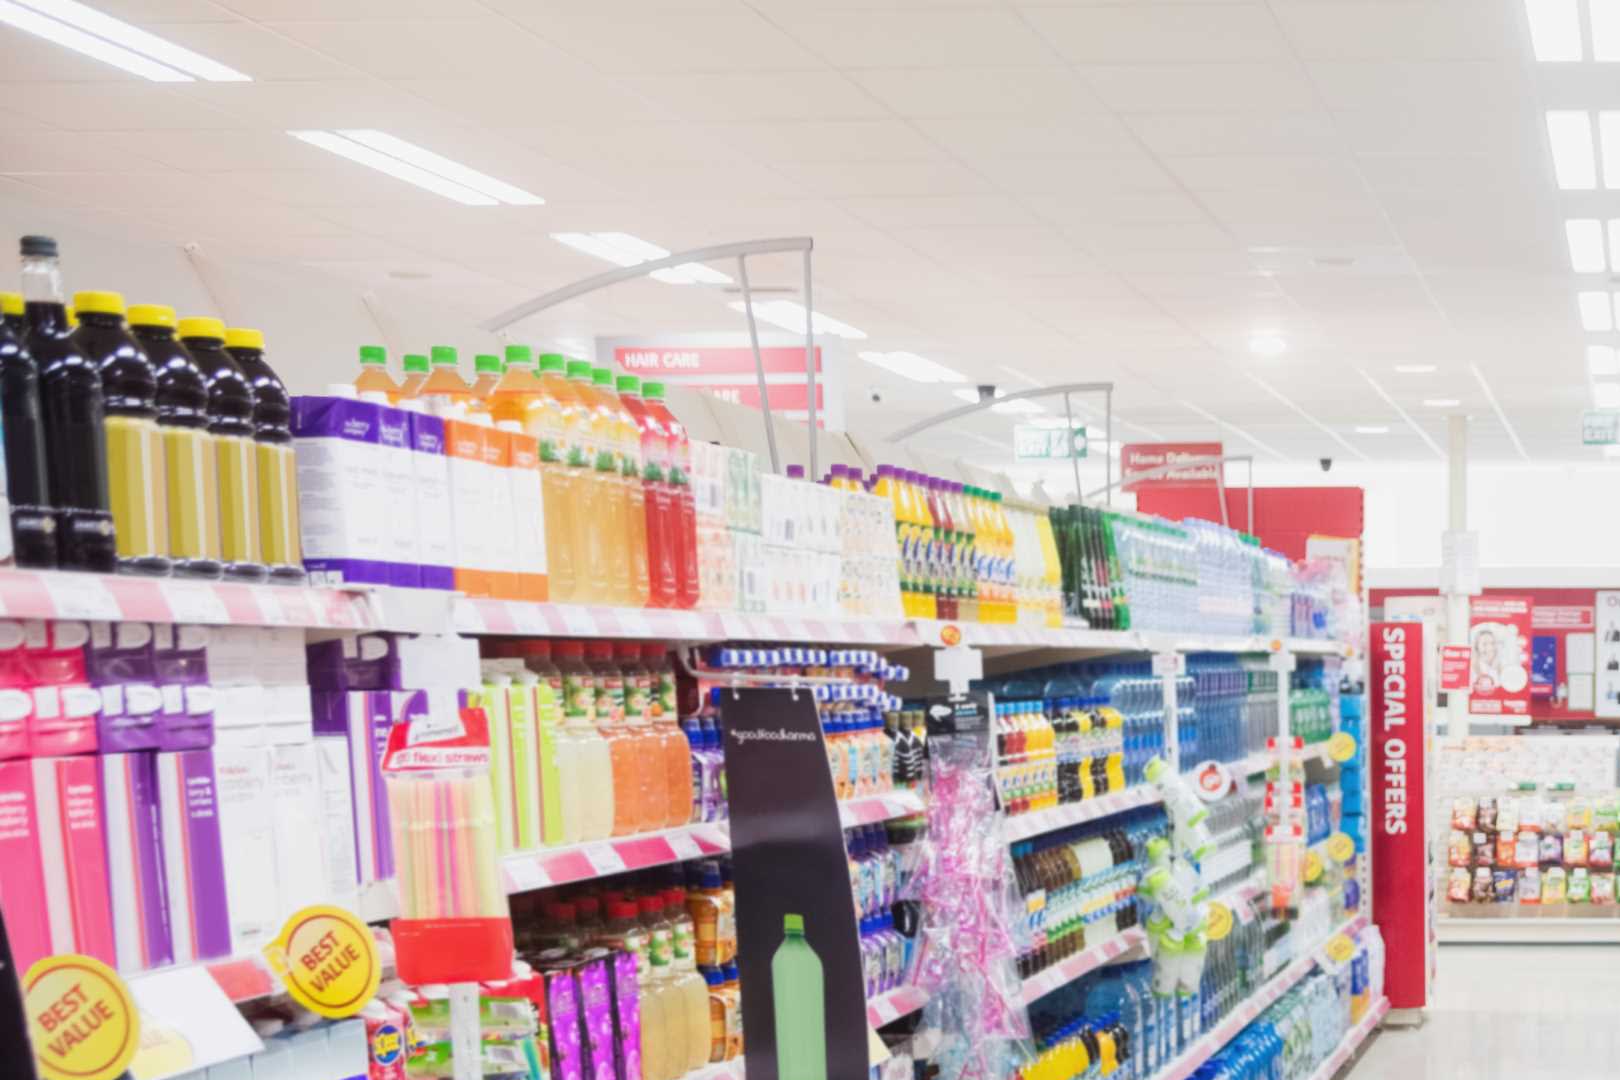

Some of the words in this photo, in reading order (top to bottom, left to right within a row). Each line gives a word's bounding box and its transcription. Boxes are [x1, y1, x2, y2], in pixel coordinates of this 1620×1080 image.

[625, 352, 658, 368] HAIR
[663, 352, 699, 368] CARE
[1383, 627, 1406, 732] SPECIAL
[1384, 738, 1407, 835] OFFERS
[300, 930, 342, 972] BEST
[309, 944, 361, 993] VALUE
[37, 983, 88, 1033] BEST
[48, 998, 115, 1059] VALUE
